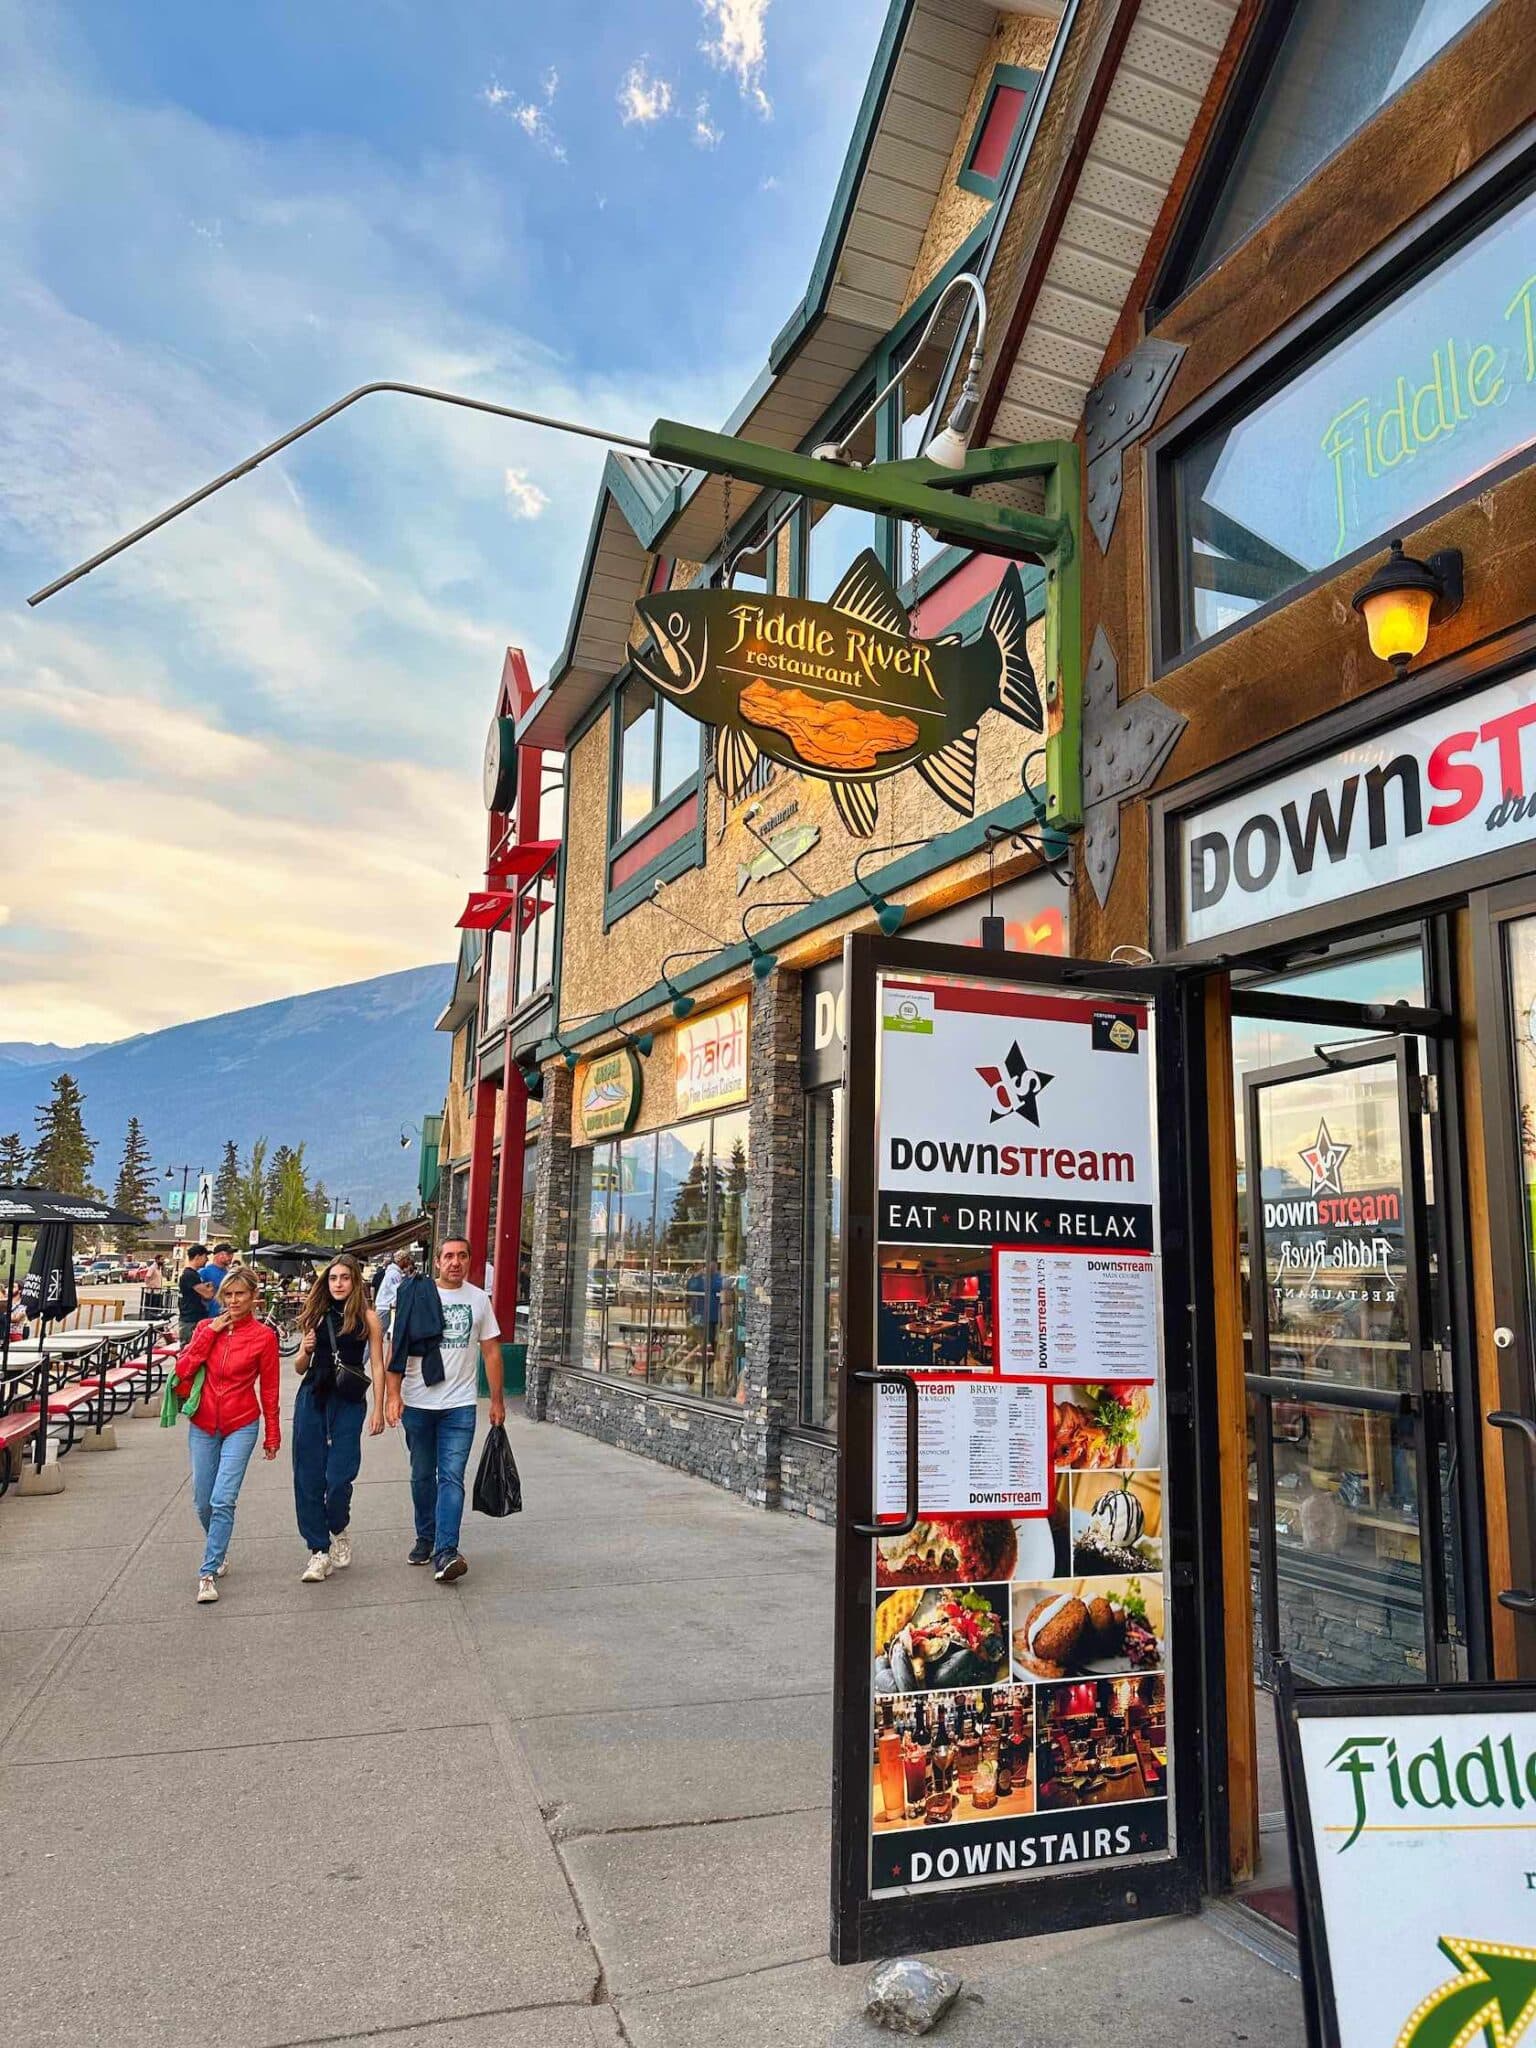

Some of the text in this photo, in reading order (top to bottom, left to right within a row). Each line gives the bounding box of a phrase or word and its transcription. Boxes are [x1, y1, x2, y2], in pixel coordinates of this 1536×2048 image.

[1321, 337, 1504, 557] Fiddle
[725, 603, 836, 657] Fiddle
[746, 648, 864, 688] restaurant
[689, 1009, 743, 1081] haldi
[889, 1204, 1137, 1238] EAT DRINK RELAX
[910, 1825, 1131, 1883] DOWNSTAIRS
